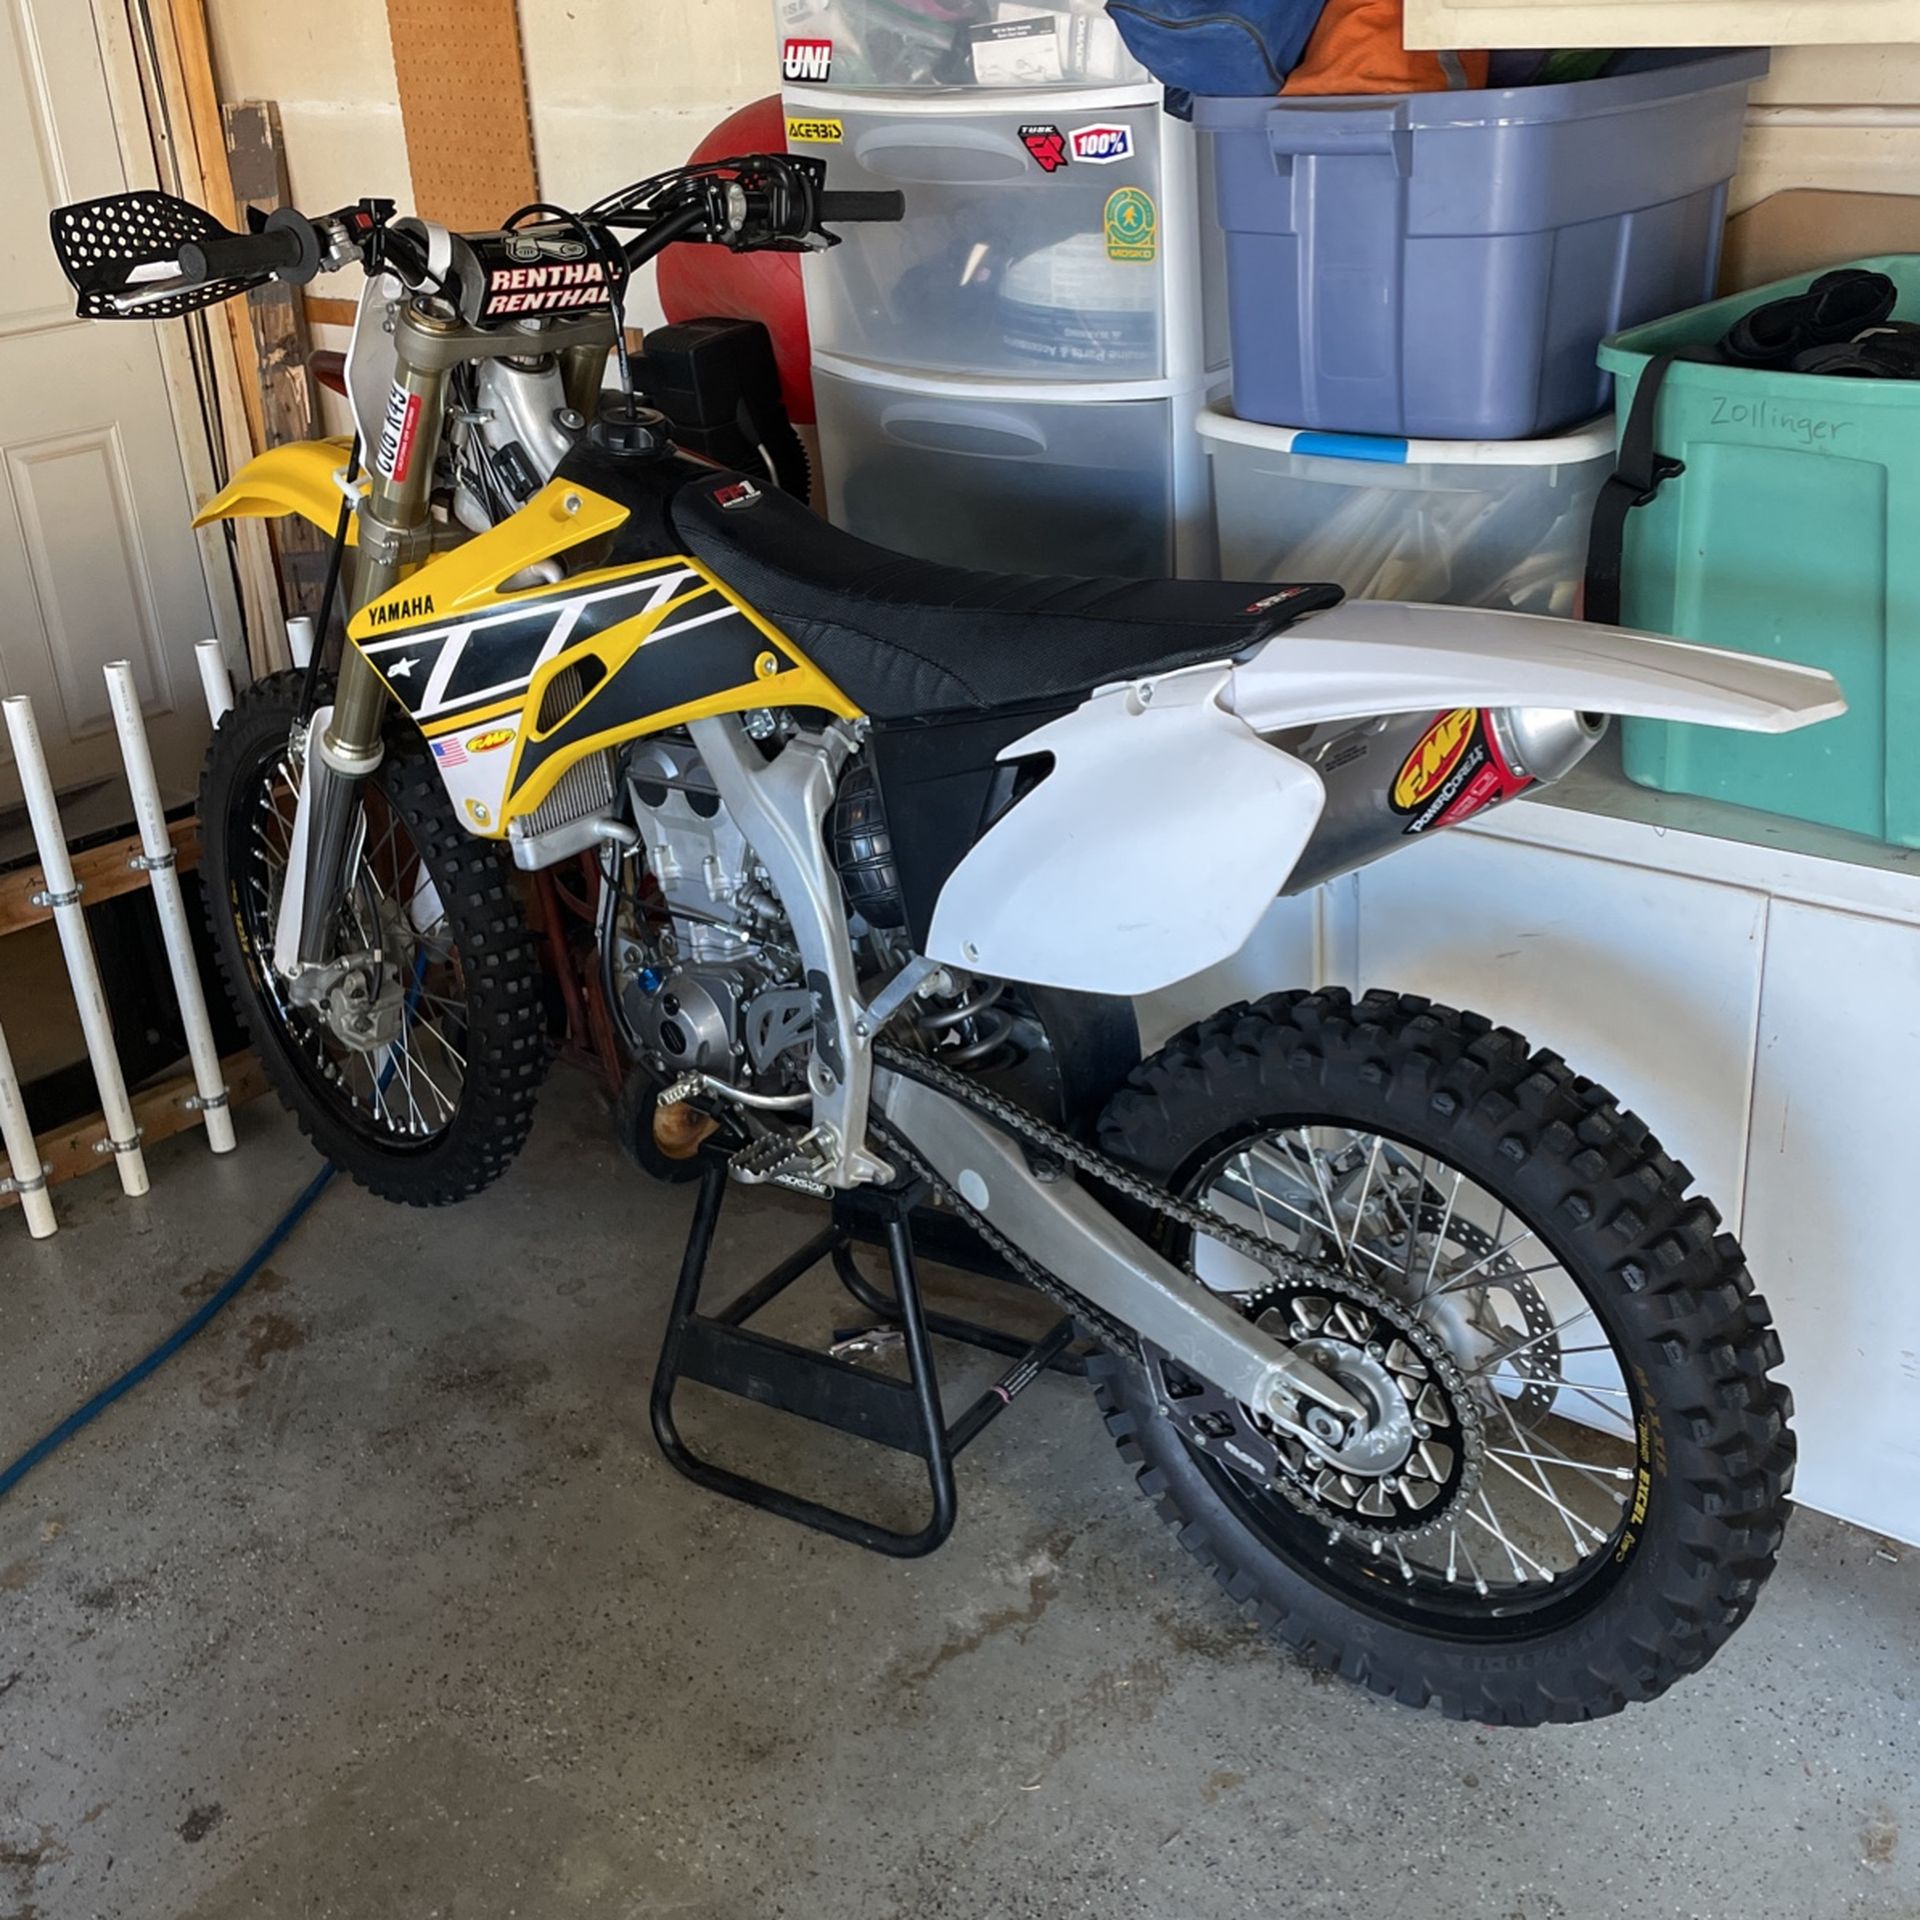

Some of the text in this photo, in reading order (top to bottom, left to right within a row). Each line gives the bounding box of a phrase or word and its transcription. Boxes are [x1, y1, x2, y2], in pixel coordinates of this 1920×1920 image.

[785, 45, 830, 79] UNI
[1021, 126, 1055, 134] TUSK
[1078, 131, 1125, 156] 100%
[486, 286, 611, 315] RENTHAL
[1711, 396, 1854, 444] Zollinger
[369, 594, 435, 627] YAMAHA
[1398, 706, 1472, 809] FMF
[1630, 1469, 1651, 1525] EXCEL
